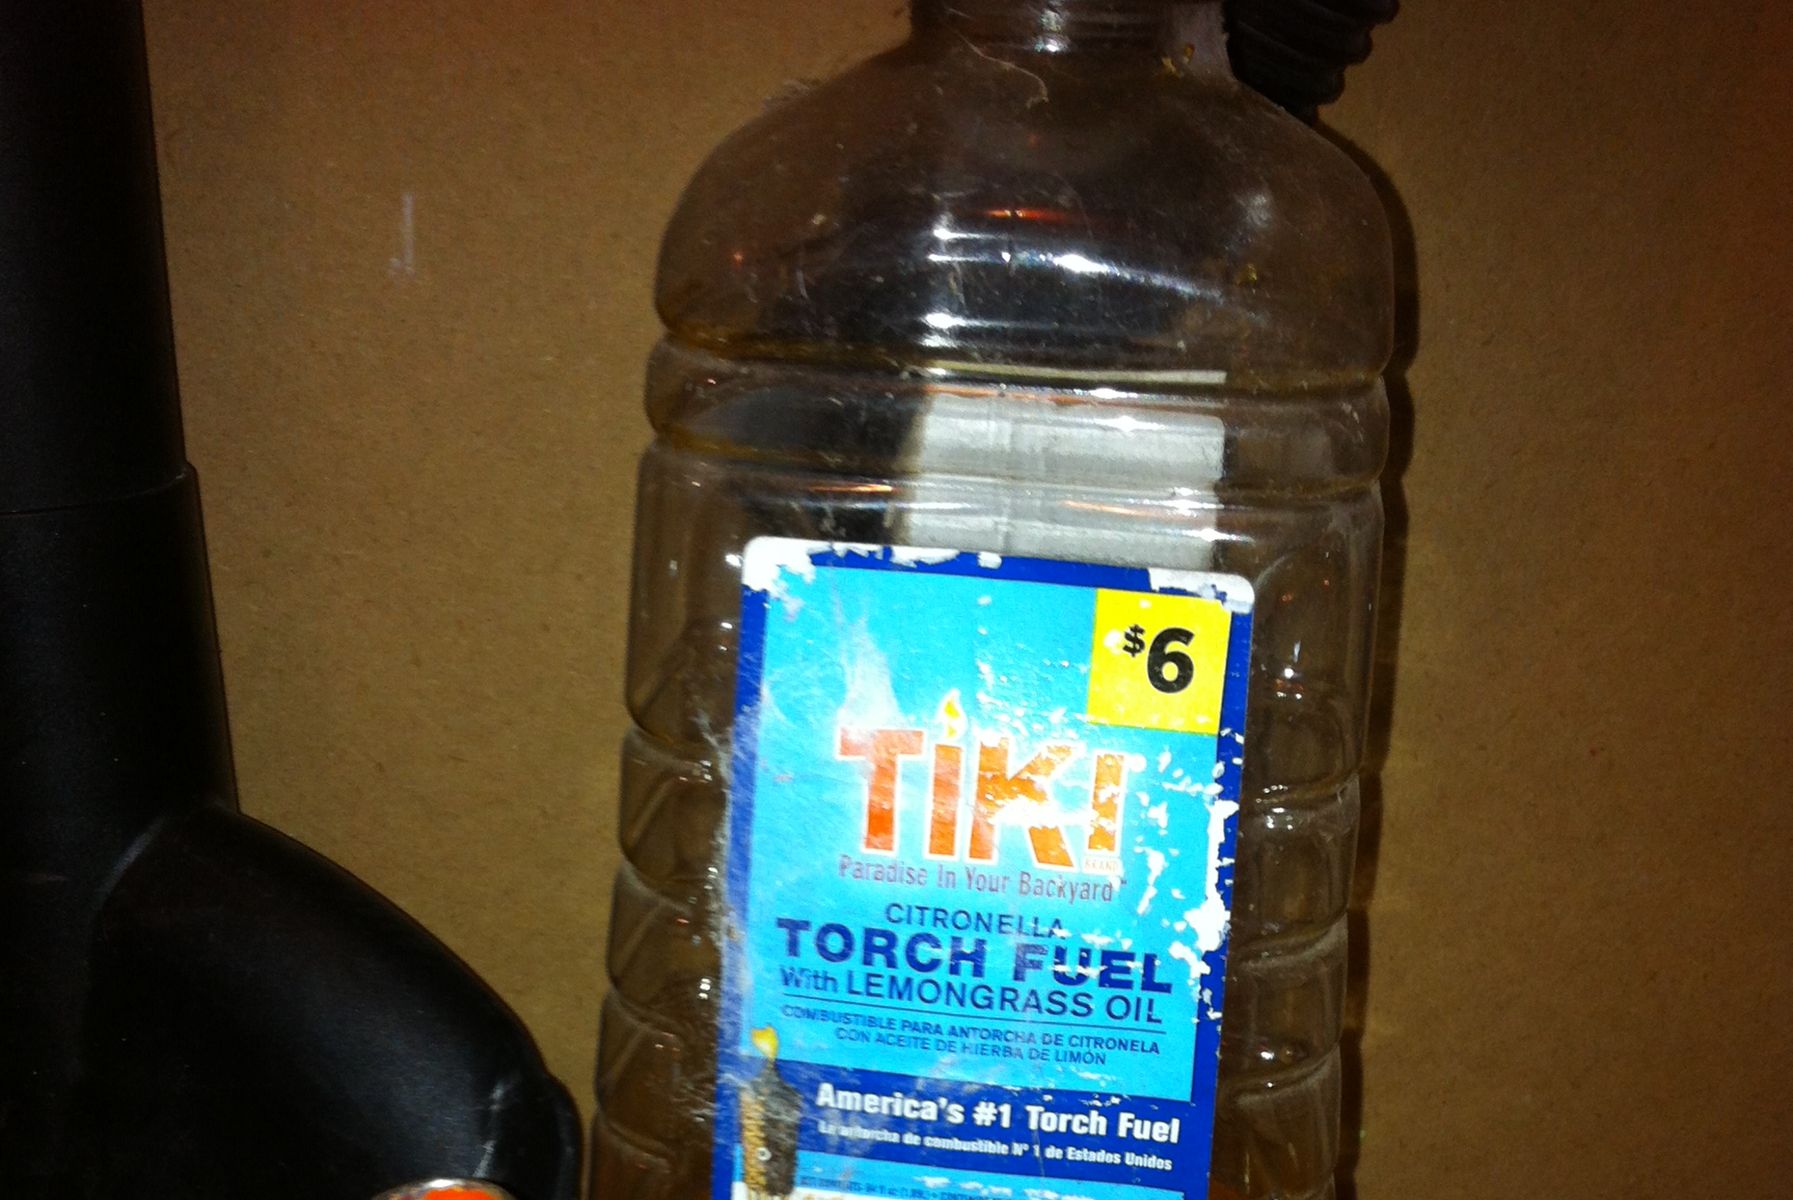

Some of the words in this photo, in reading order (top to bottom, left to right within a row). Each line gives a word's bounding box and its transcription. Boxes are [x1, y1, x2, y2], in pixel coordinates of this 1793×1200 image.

[1122, 624, 1195, 694] $6
[838, 854, 928, 887] Paradise
[937, 865, 957, 889] In
[965, 867, 1010, 893] Your
[886, 903, 1067, 940] CITRONELLA
[776, 917, 987, 978] TORCH
[1012, 942, 1173, 994] FUEL
[779, 964, 839, 993] With
[847, 970, 1095, 1018] LEMONGRASS
[1105, 994, 1163, 1025] OIL
[780, 1003, 898, 1031] COMBUSTIBLE
[901, 1019, 943, 1036] PARA
[948, 1024, 1038, 1046] ANTORCHA
[1042, 1033, 1064, 1047] DE
[1068, 1034, 1161, 1055] CITRONELA
[835, 1026, 871, 1043] CON
[875, 1032, 931, 1051] ACEITE
[936, 1038, 957, 1053] DE
[962, 1041, 1024, 1060] HIERBA
[1028, 1047, 1051, 1062] DE
[1054, 1047, 1107, 1065] LIMÓN
[815, 1081, 965, 1125] America's
[972, 1100, 1012, 1129] #1
[1024, 1104, 1108, 1136] Torch
[1117, 1111, 1181, 1144] Fuel
[902, 1132, 922, 1146] de
[923, 1136, 1009, 1156] combustible
[1032, 1144, 1041, 1158] 1
[1045, 1145, 1063, 1160] de
[1066, 1146, 1122, 1165] Estados
[1124, 1151, 1173, 1171] Unidos
